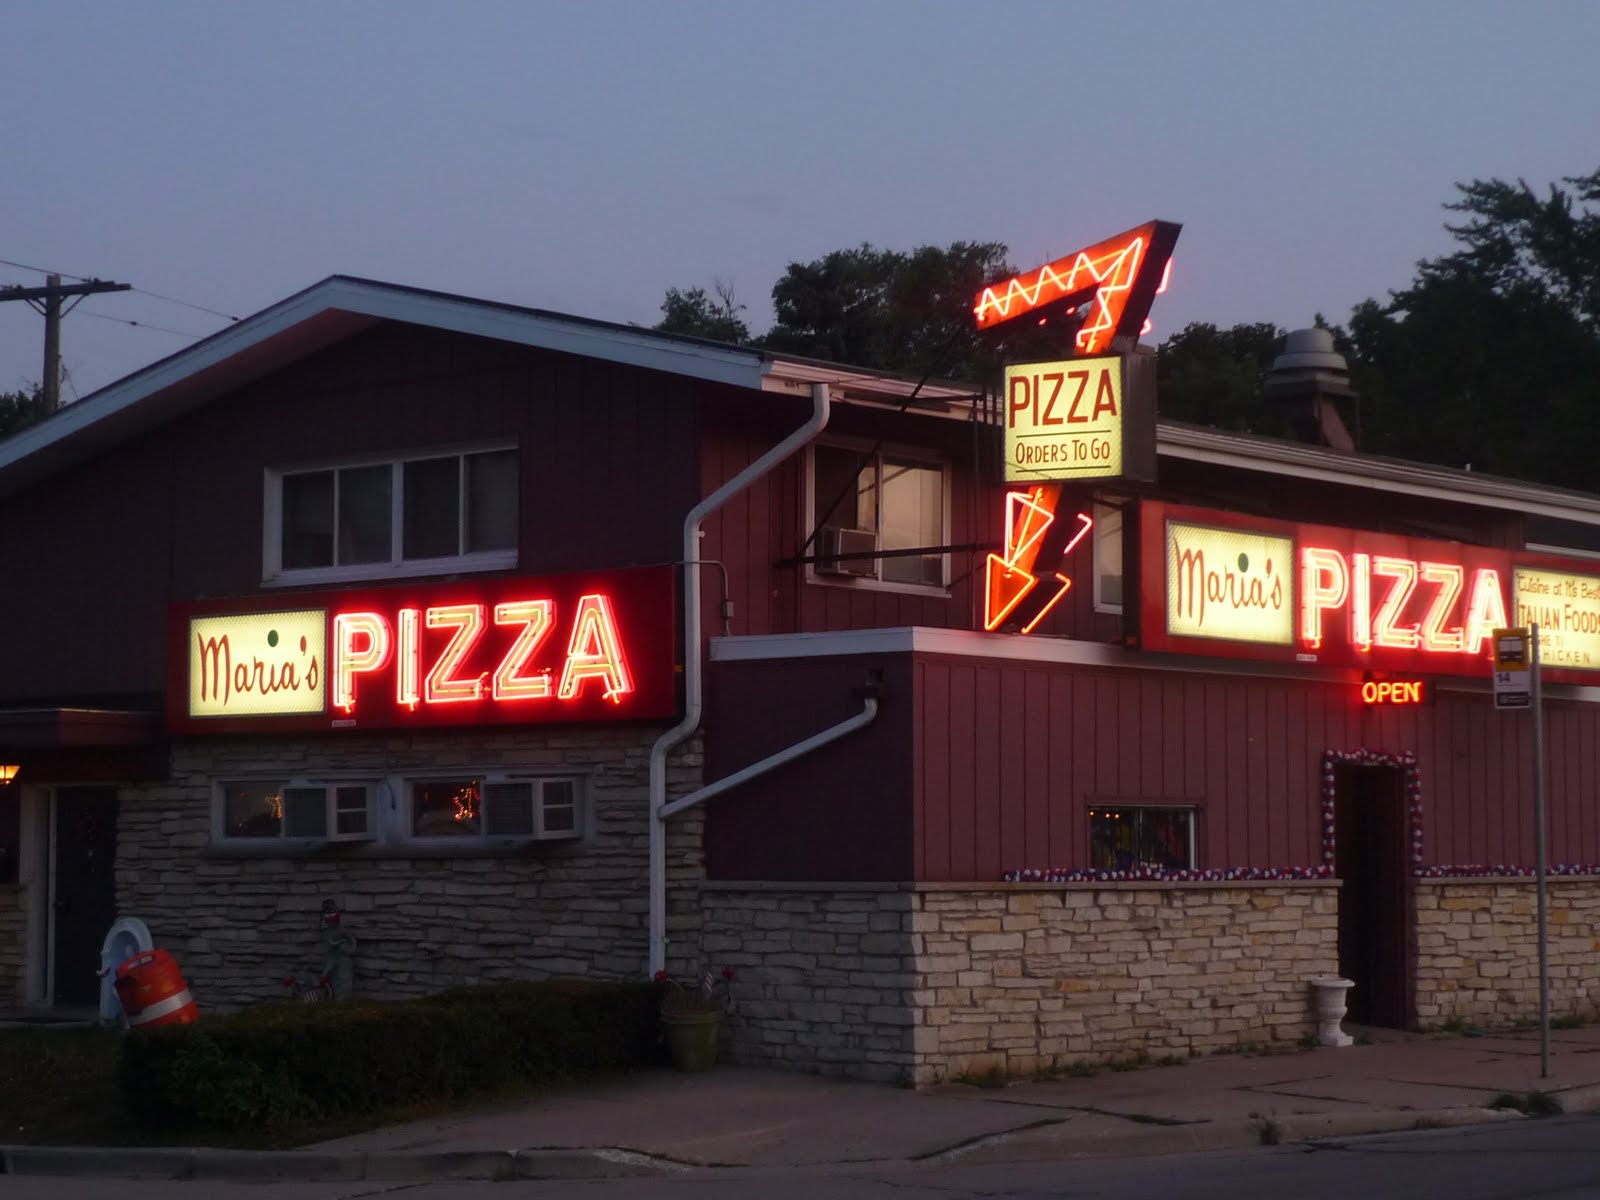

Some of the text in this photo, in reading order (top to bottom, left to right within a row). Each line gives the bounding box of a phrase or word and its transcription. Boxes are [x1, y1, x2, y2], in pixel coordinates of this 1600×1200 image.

[1009, 368, 1117, 428] PIZZA
[1072, 439, 1088, 461] TO
[1091, 438, 1110, 460] GO
[1173, 537, 1508, 654] Maria's PIZZA
[198, 594, 635, 706] Maria's PIZZA
[1539, 649, 1590, 664] HICKEN
[1497, 672, 1511, 684] 14
[1361, 681, 1422, 703] OPEN
